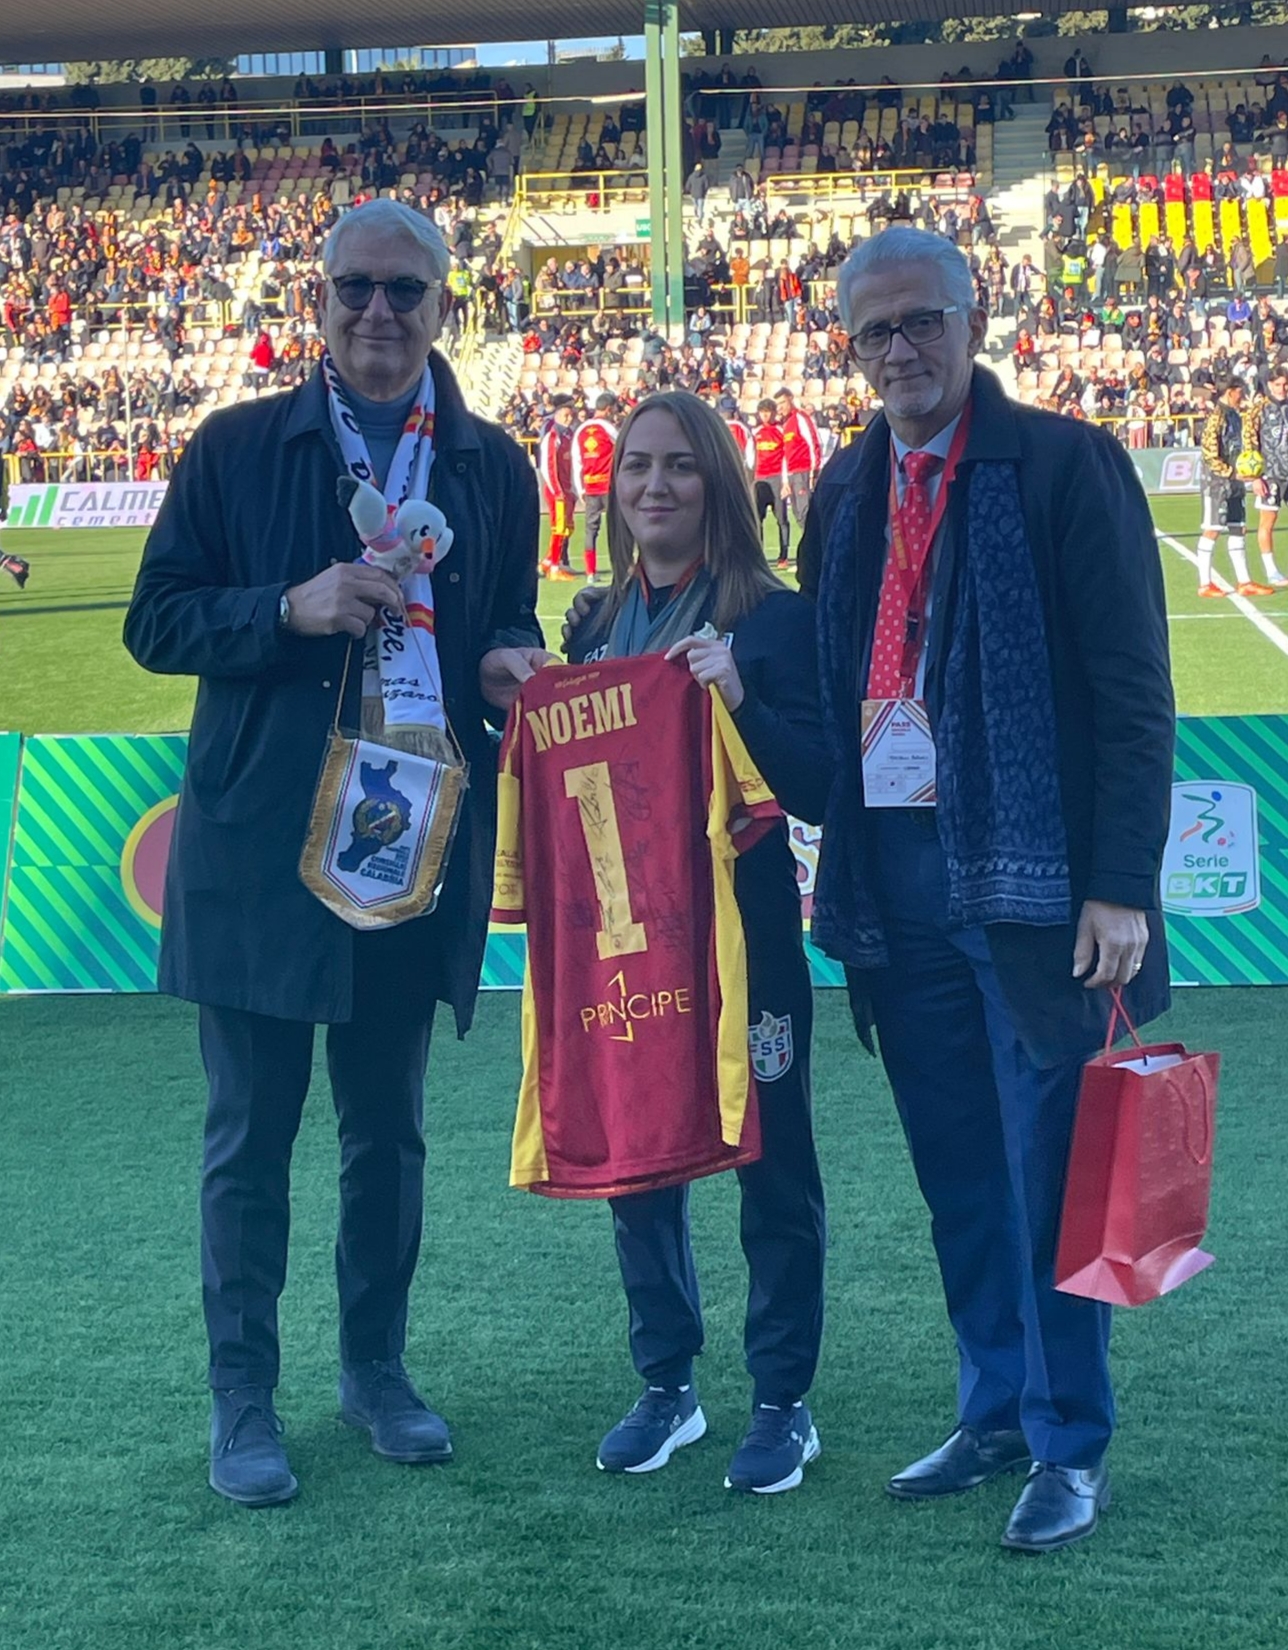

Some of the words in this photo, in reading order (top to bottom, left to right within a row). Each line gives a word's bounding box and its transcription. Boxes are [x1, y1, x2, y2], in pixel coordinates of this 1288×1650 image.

[60, 490, 165, 511] CALME
[526, 683, 637, 753] NOEMI
[563, 761, 647, 960] 1
[1183, 854, 1229, 868] Serie
[1167, 874, 1246, 896] BKT
